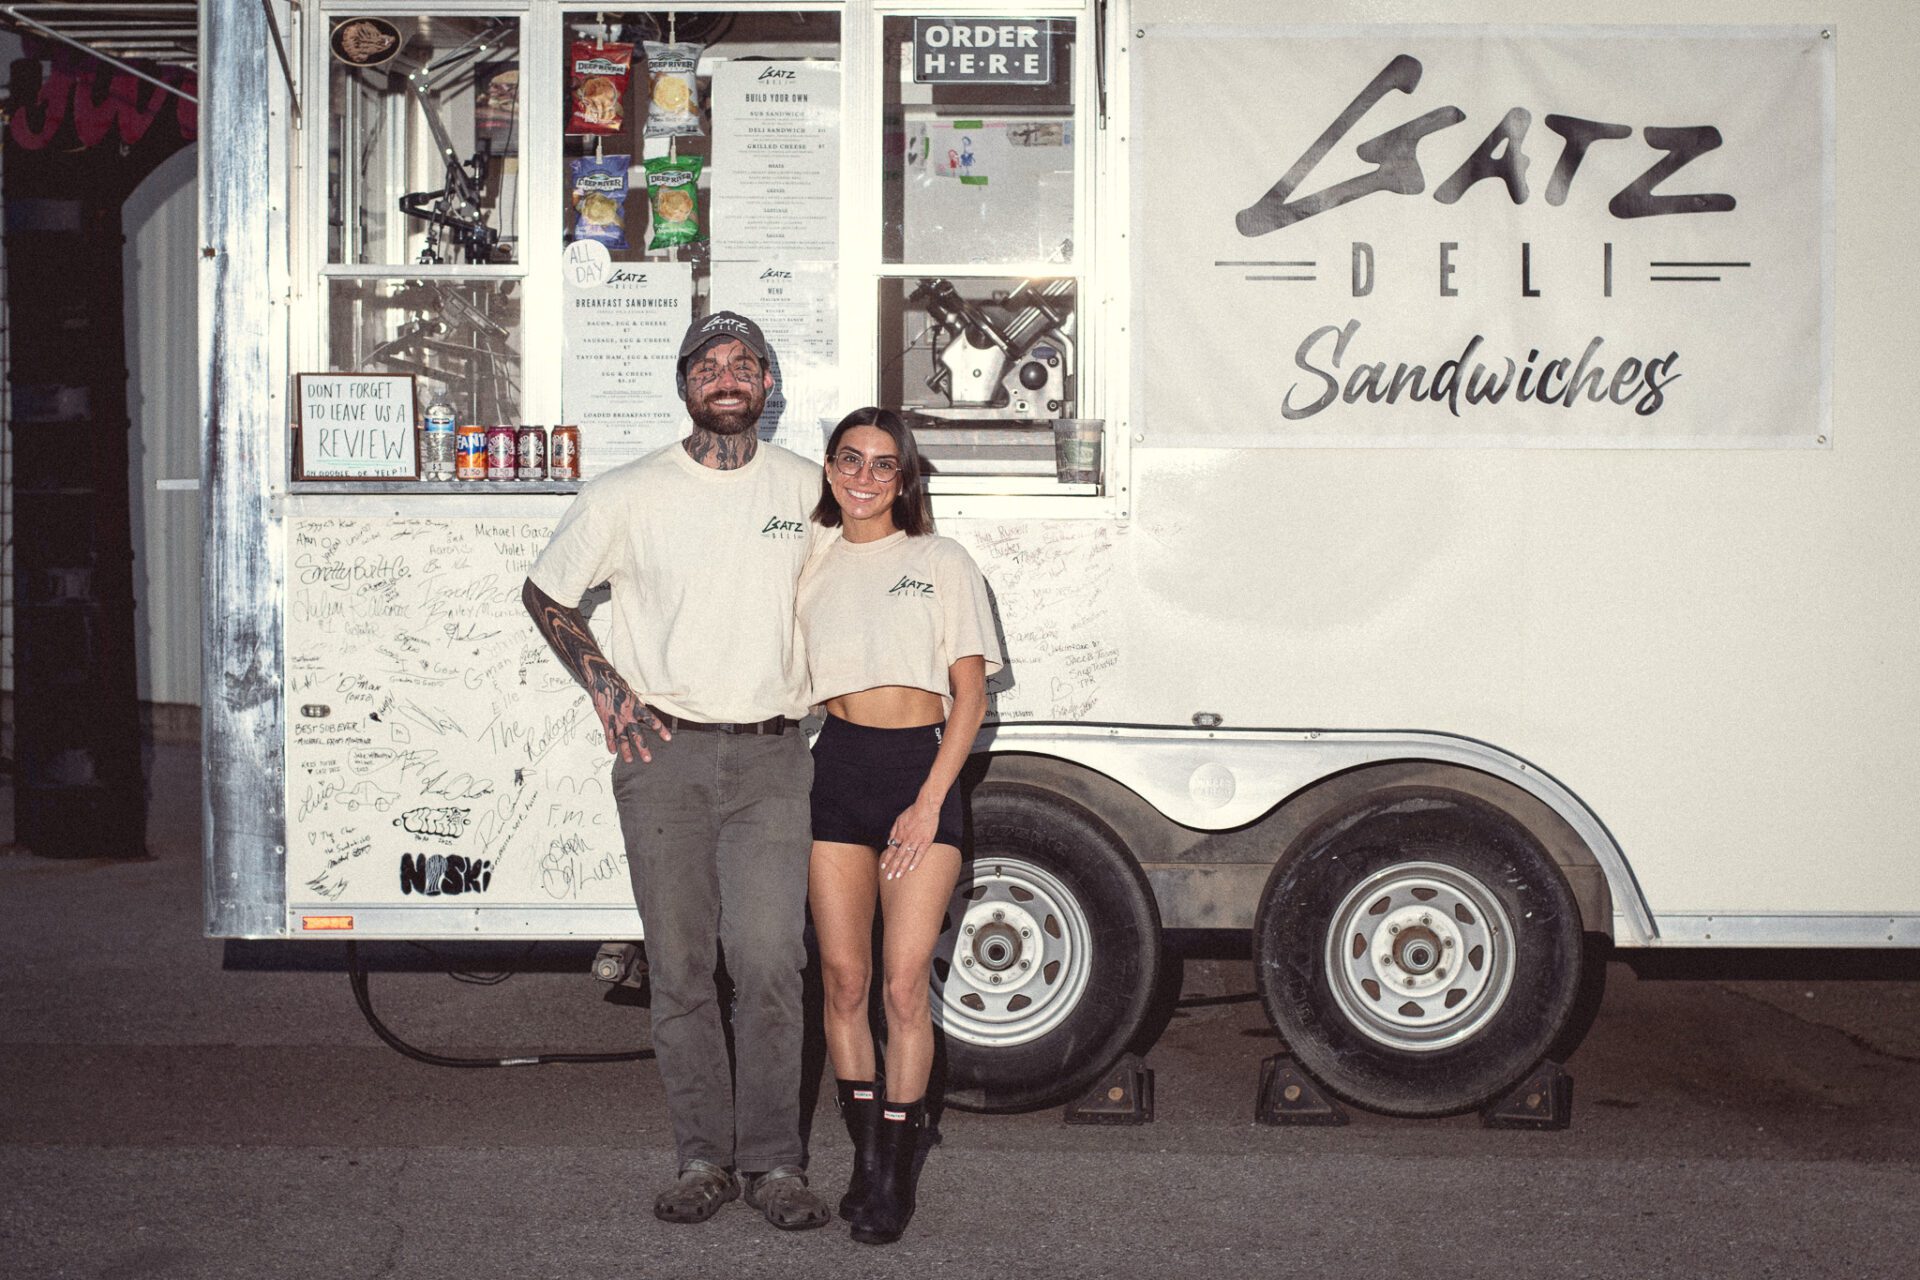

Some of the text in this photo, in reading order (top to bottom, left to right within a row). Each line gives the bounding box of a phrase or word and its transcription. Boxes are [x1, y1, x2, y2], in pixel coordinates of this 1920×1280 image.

[925, 25, 1039, 48] ORDER
[667, 60, 694, 69] RIVER
[746, 93, 808, 102] BUILD YOUR OWN
[651, 173, 692, 183] DEEP RIVER
[570, 244, 596, 264] ALL
[576, 262, 604, 283] DAY
[1352, 242, 1613, 297] DELI
[575, 298, 678, 308] BREAKFAST SANDWICHES
[1280, 318, 1683, 420] Sandwiches
[350, 382, 393, 399] FORGET
[308, 404, 405, 423] TO LEAVE US A
[319, 427, 406, 460] REVIEW
[475, 523, 516, 538] Michael
[494, 542, 525, 557] Violet
